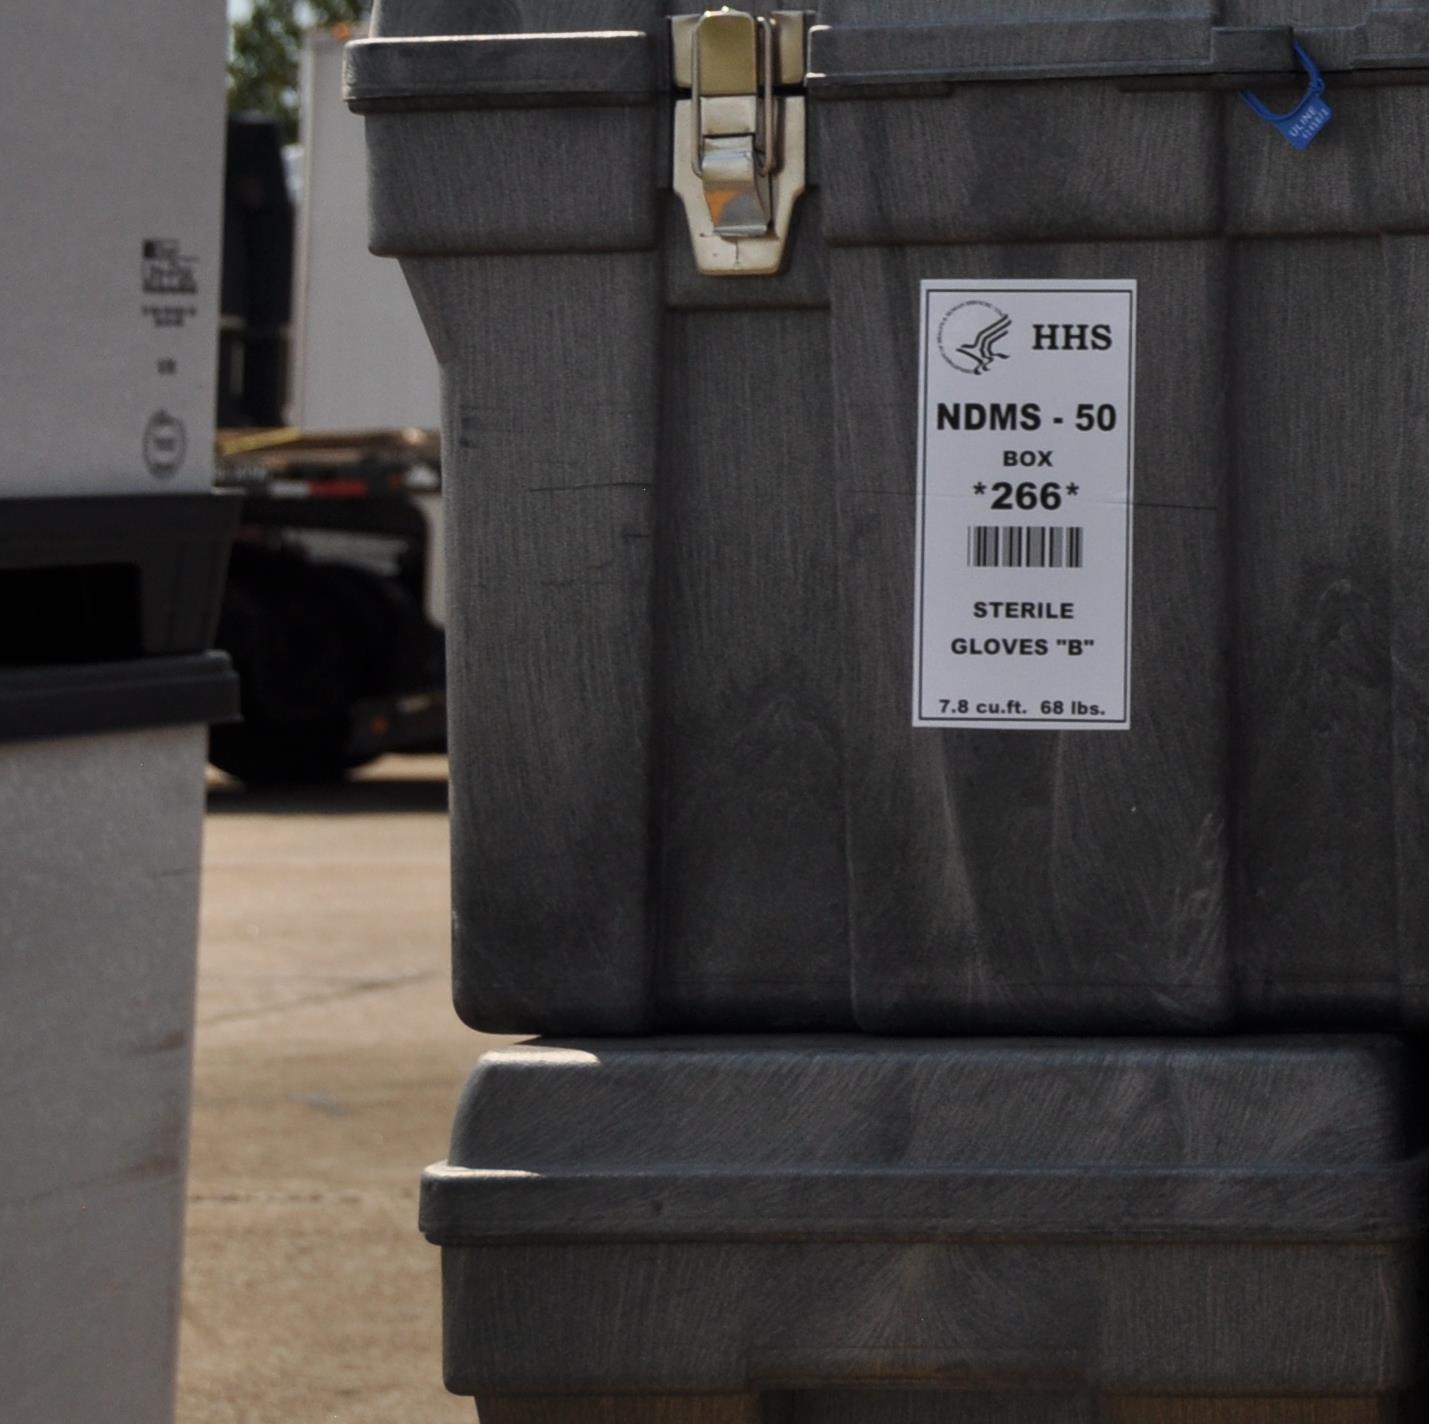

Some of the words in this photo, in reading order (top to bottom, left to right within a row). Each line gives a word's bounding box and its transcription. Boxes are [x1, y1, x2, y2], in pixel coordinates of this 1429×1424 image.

[1031, 323, 1113, 351] HHS
[936, 402, 1042, 432] NDMS
[1075, 403, 1117, 432] 50
[1003, 450, 1053, 467] BOX
[973, 601, 1074, 620] STERILE
[950, 637, 1049, 656] GLOVES
[1056, 638, 1095, 656] "B"
[938, 698, 969, 714] 7.8
[975, 699, 1027, 715] cu.ft.
[1040, 700, 1065, 715] 68
[1071, 700, 1106, 716] lbs.
